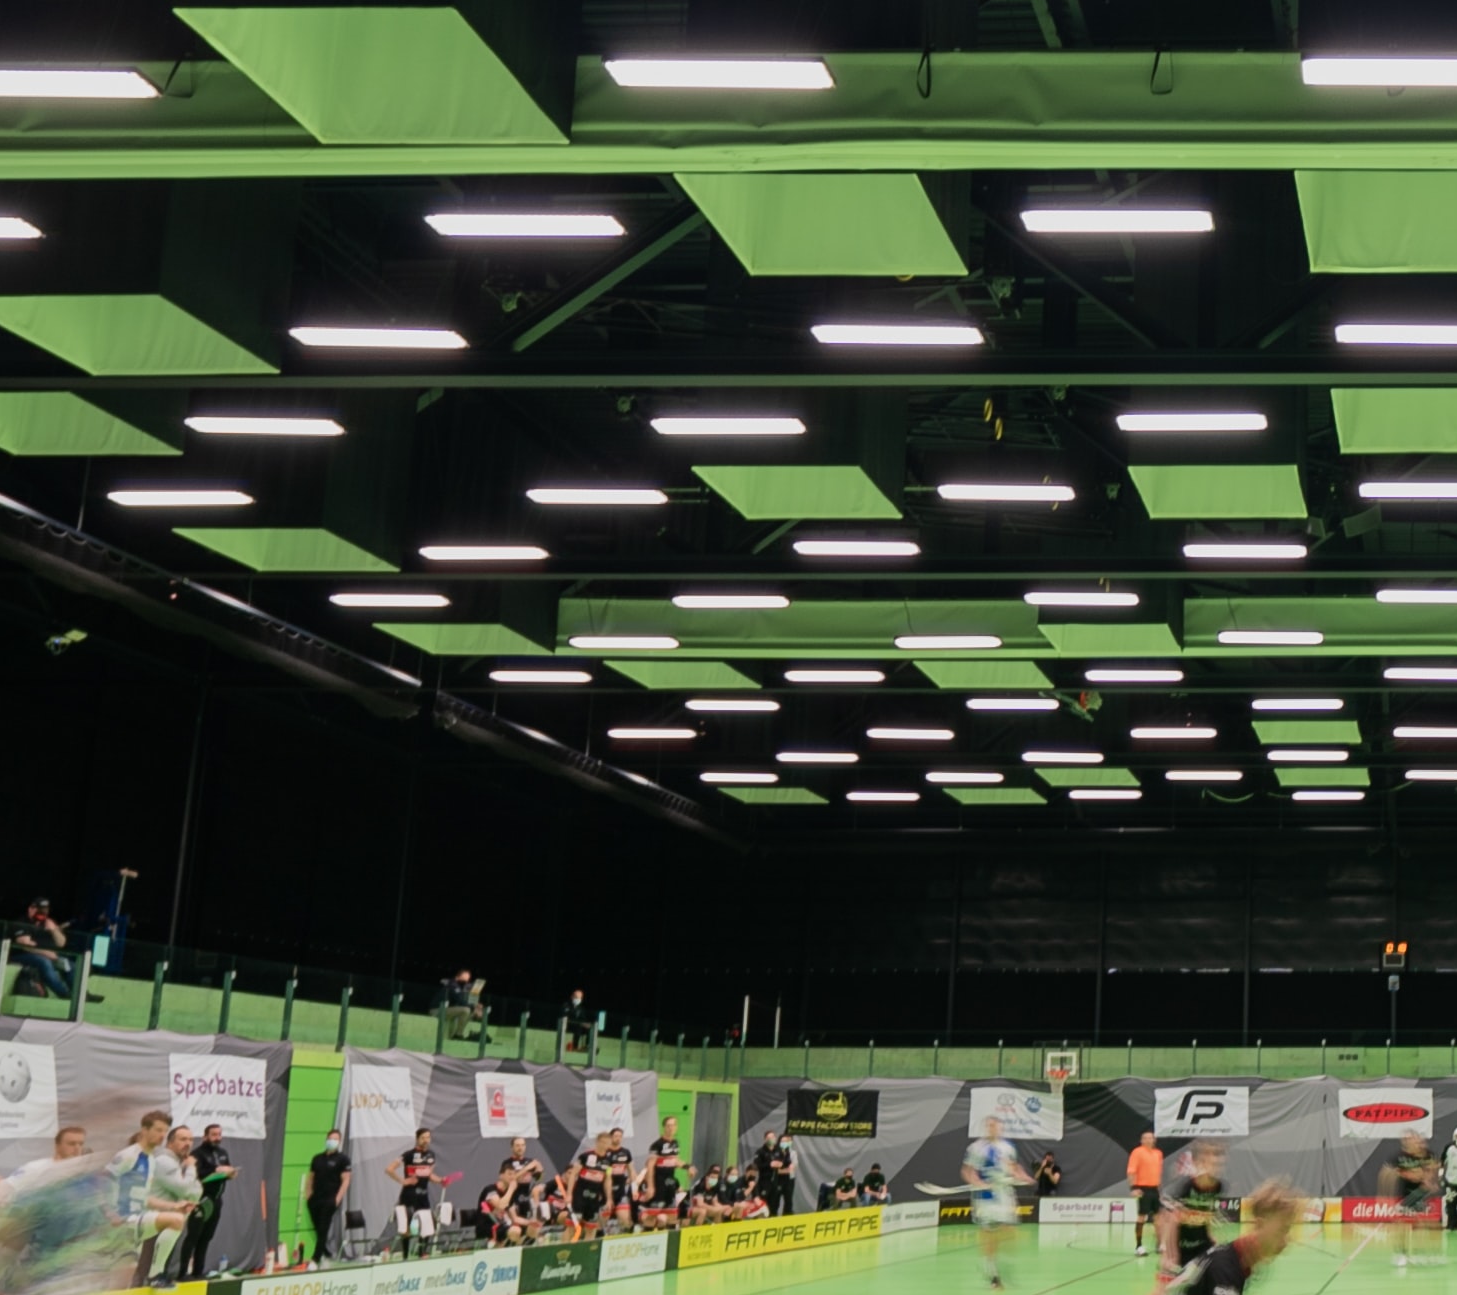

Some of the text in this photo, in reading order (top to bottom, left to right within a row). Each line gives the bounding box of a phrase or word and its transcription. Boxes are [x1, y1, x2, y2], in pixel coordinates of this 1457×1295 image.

[174, 1072, 262, 1099] Sparbatze
[1355, 1108, 1419, 1118] FAT PIPE
[1052, 1203, 1103, 1212] Sparbatze
[725, 1224, 806, 1251] FAT PIPE
[814, 1219, 845, 1239] FAT
[847, 1214, 879, 1234] PIPE
